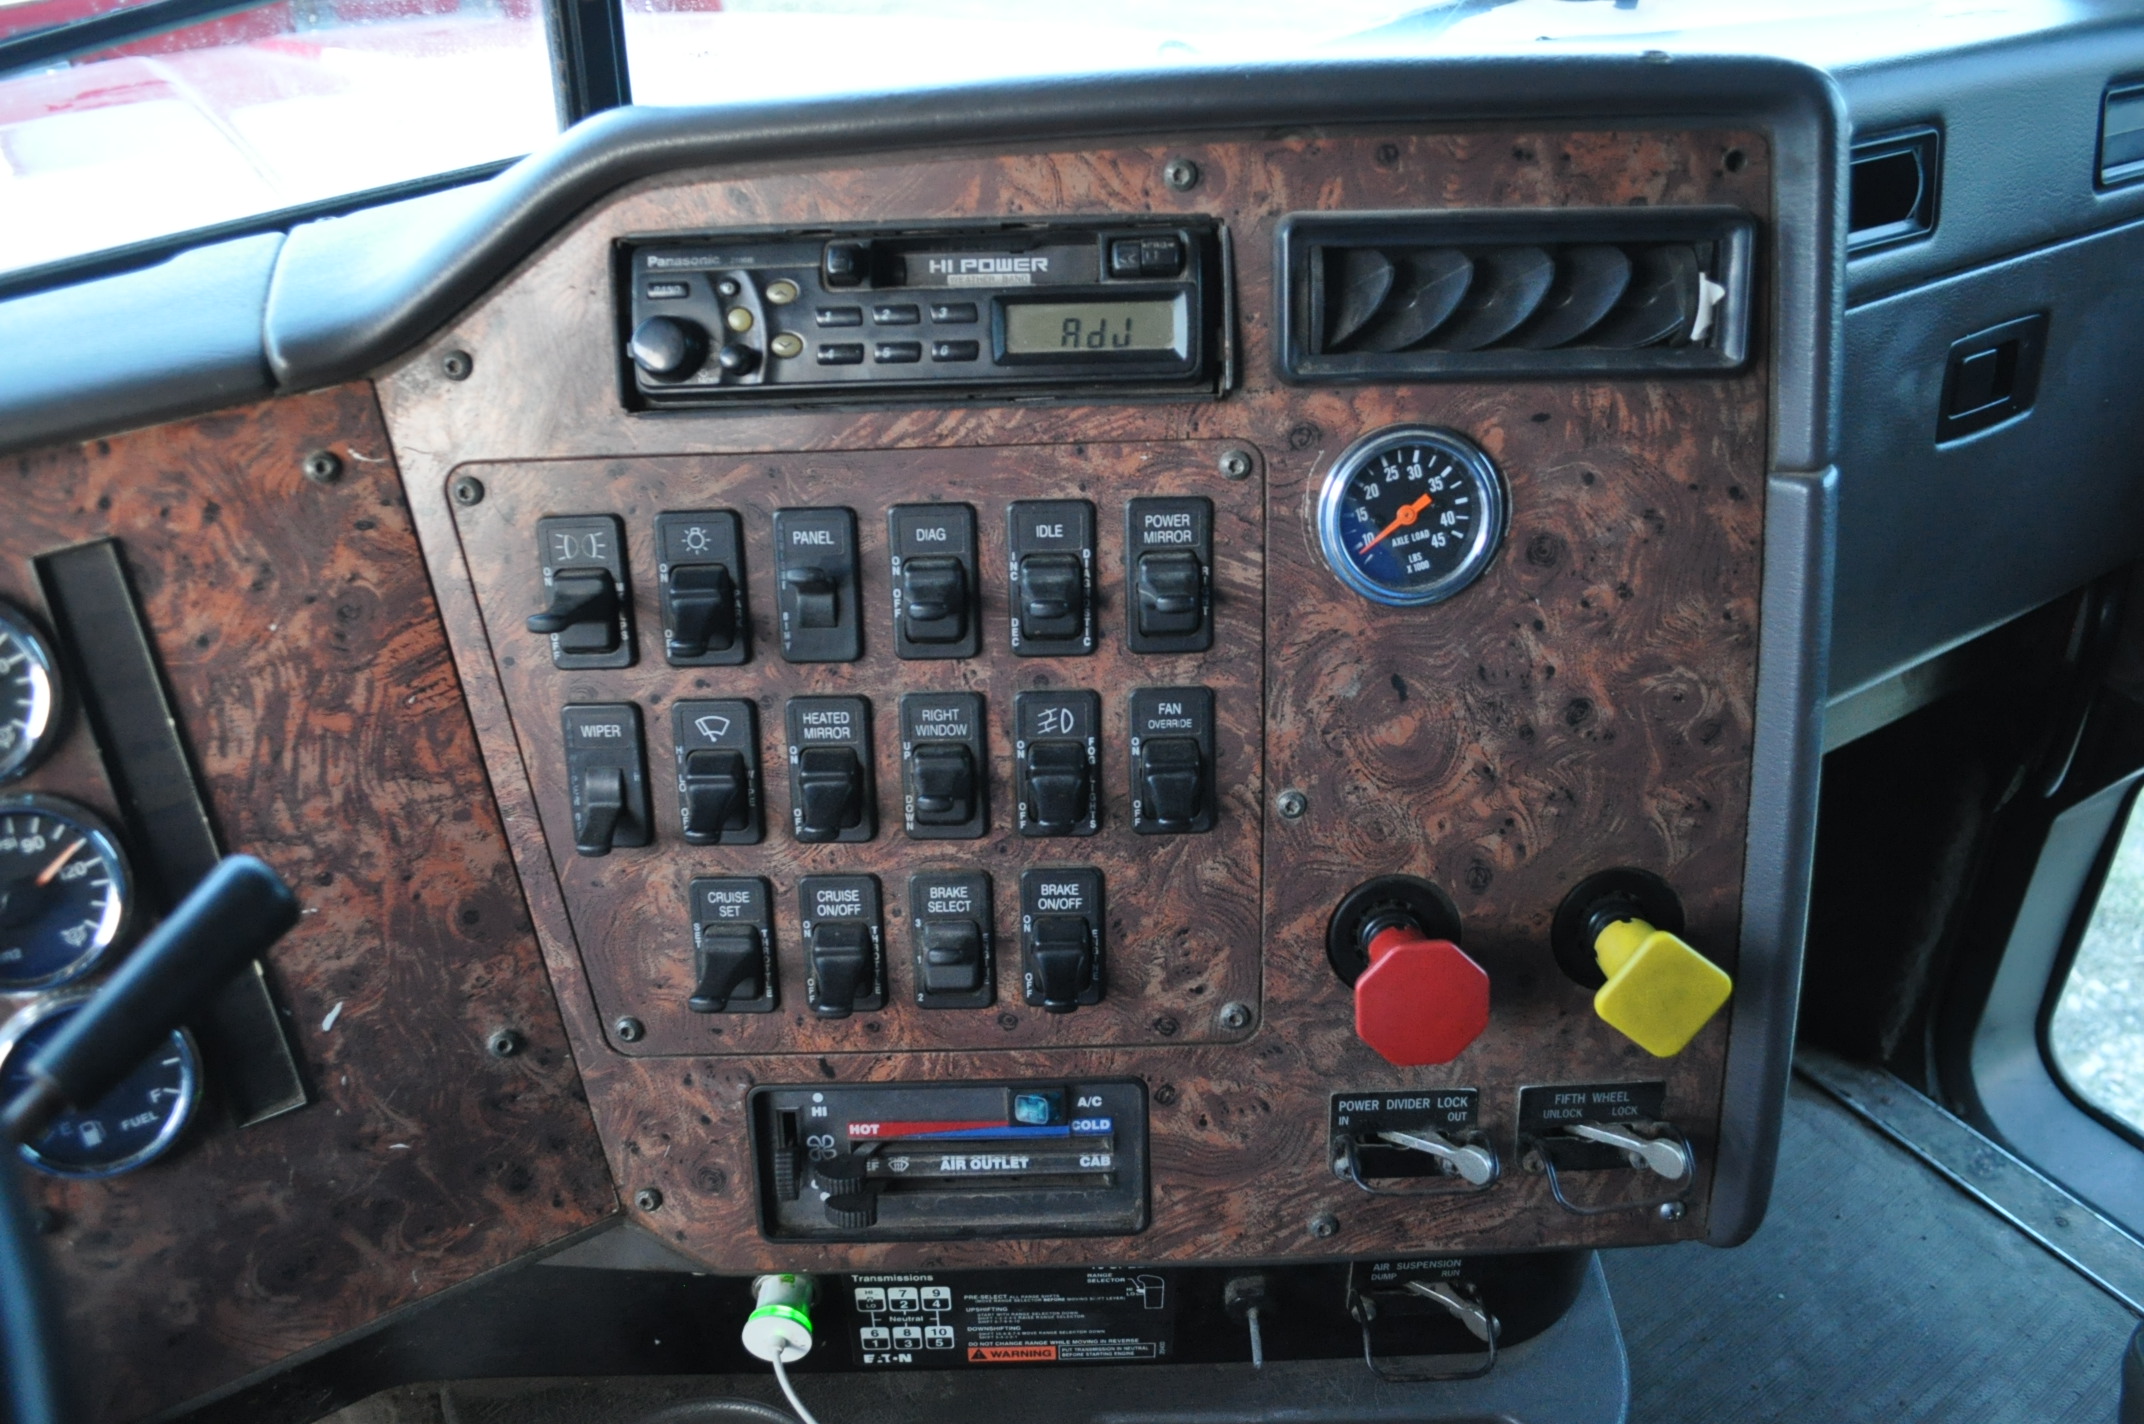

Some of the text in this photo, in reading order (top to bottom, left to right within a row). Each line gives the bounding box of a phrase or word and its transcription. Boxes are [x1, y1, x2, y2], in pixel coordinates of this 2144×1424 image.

[647, 255, 720, 268] Panasonic
[929, 257, 1048, 274] HI POWER
[949, 273, 1028, 284] WEATHER BAND
[824, 311, 832, 322] 1
[882, 309, 890, 320] 2
[938, 306, 948, 318] 3
[826, 349, 835, 360] 4
[881, 347, 891, 358] 5
[940, 345, 949, 357] 6
[1383, 465, 1400, 482] 25
[1406, 463, 1423, 481] 30
[1427, 475, 1444, 493] 35
[1363, 483, 1380, 501] 20
[1144, 514, 1191, 528] POWER
[1355, 506, 1369, 523] 15
[1439, 510, 1456, 527] 40
[792, 530, 835, 545] PANEL
[916, 528, 947, 542] DIAG
[1036, 524, 1064, 538] IDLE
[1144, 530, 1192, 544] MIRROR
[1361, 531, 1376, 546] 10
[1391, 529, 1431, 548] AXLE LOAD
[1430, 532, 1446, 549] 45
[1408, 552, 1423, 564] LBS
[659, 563, 669, 583] ON
[892, 556, 900, 576] ON
[1009, 552, 1018, 581] INC
[1406, 560, 1431, 574] X 1000
[543, 567, 553, 586] ON
[893, 589, 901, 618] OFF
[1011, 618, 1020, 647] DEC
[550, 633, 560, 660] OFF
[921, 708, 959, 722] RIGHT
[1158, 703, 1182, 715] FAN
[803, 712, 849, 725] HEATED
[1148, 718, 1193, 730] OVERRIDE
[580, 725, 621, 738] WIPER
[803, 726, 851, 740] MIRROR
[915, 722, 968, 737] WINDOW
[903, 742, 911, 760] UP
[1016, 740, 1025, 759] ON
[1131, 737, 1140, 756] ON
[675, 745, 684, 764] HI
[789, 745, 799, 765] ON
[678, 774, 687, 793] LO
[1088, 737, 1097, 829] FOG LIGHTS
[905, 795, 914, 832] DOWN
[1018, 802, 1027, 830] OFF
[1133, 800, 1141, 827] OFF
[793, 808, 802, 836] OFF
[20, 835, 46, 854] 90
[707, 891, 750, 904] CRUISE
[816, 889, 860, 903] CRUISE
[929, 886, 968, 900] BRAKE
[1040, 884, 1080, 898] BRAKE
[816, 902, 862, 917] ON/OFF
[927, 899, 972, 914] SELECT
[1037, 897, 1083, 911] ON/OFF
[719, 905, 741, 918] SET
[803, 921, 812, 939] ON
[914, 918, 922, 928] 3
[1023, 914, 1032, 933] ON
[693, 923, 702, 949] SET
[760, 929, 774, 998] THROTTLE
[806, 978, 816, 1004] OFF
[1024, 972, 1033, 998] OFF
[916, 993, 924, 1002] 2
[150, 1087, 162, 1104] F
[1077, 1096, 1103, 1109] A/C
[1554, 1091, 1630, 1105] FIFTH WHEEL
[1338, 1096, 1468, 1112] POWER DIVIDER LOCK
[1611, 1105, 1638, 1117] LOCK
[811, 1106, 828, 1117] HI
[1447, 1111, 1467, 1123] OUT
[1543, 1107, 1583, 1120] UNLOCK
[121, 1110, 159, 1132] FUEL
[1072, 1118, 1111, 1131] COLD
[1338, 1116, 1349, 1127] IN
[849, 1124, 880, 1136] HOT
[940, 1156, 1029, 1171] AIR OUTLET
[1079, 1156, 1111, 1168] CAB
[1372, 1258, 1462, 1272] AIR SUSPENSION
[850, 1273, 934, 1283] Transmissions
[1371, 1272, 1398, 1281] DUMP
[1441, 1269, 1461, 1278] RUN
[899, 1289, 908, 1298] 7
[932, 1288, 941, 1297] 9
[899, 1300, 909, 1309] 2
[931, 1299, 941, 1308] 4
[888, 1315, 924, 1323] Neutral
[870, 1329, 880, 1338] 6
[903, 1328, 912, 1337] 8
[930, 1328, 947, 1337] 10
[871, 1339, 880, 1349] 1
[903, 1339, 913, 1348] 3
[935, 1338, 945, 1348] 5
[990, 1348, 1052, 1359] WARNING
